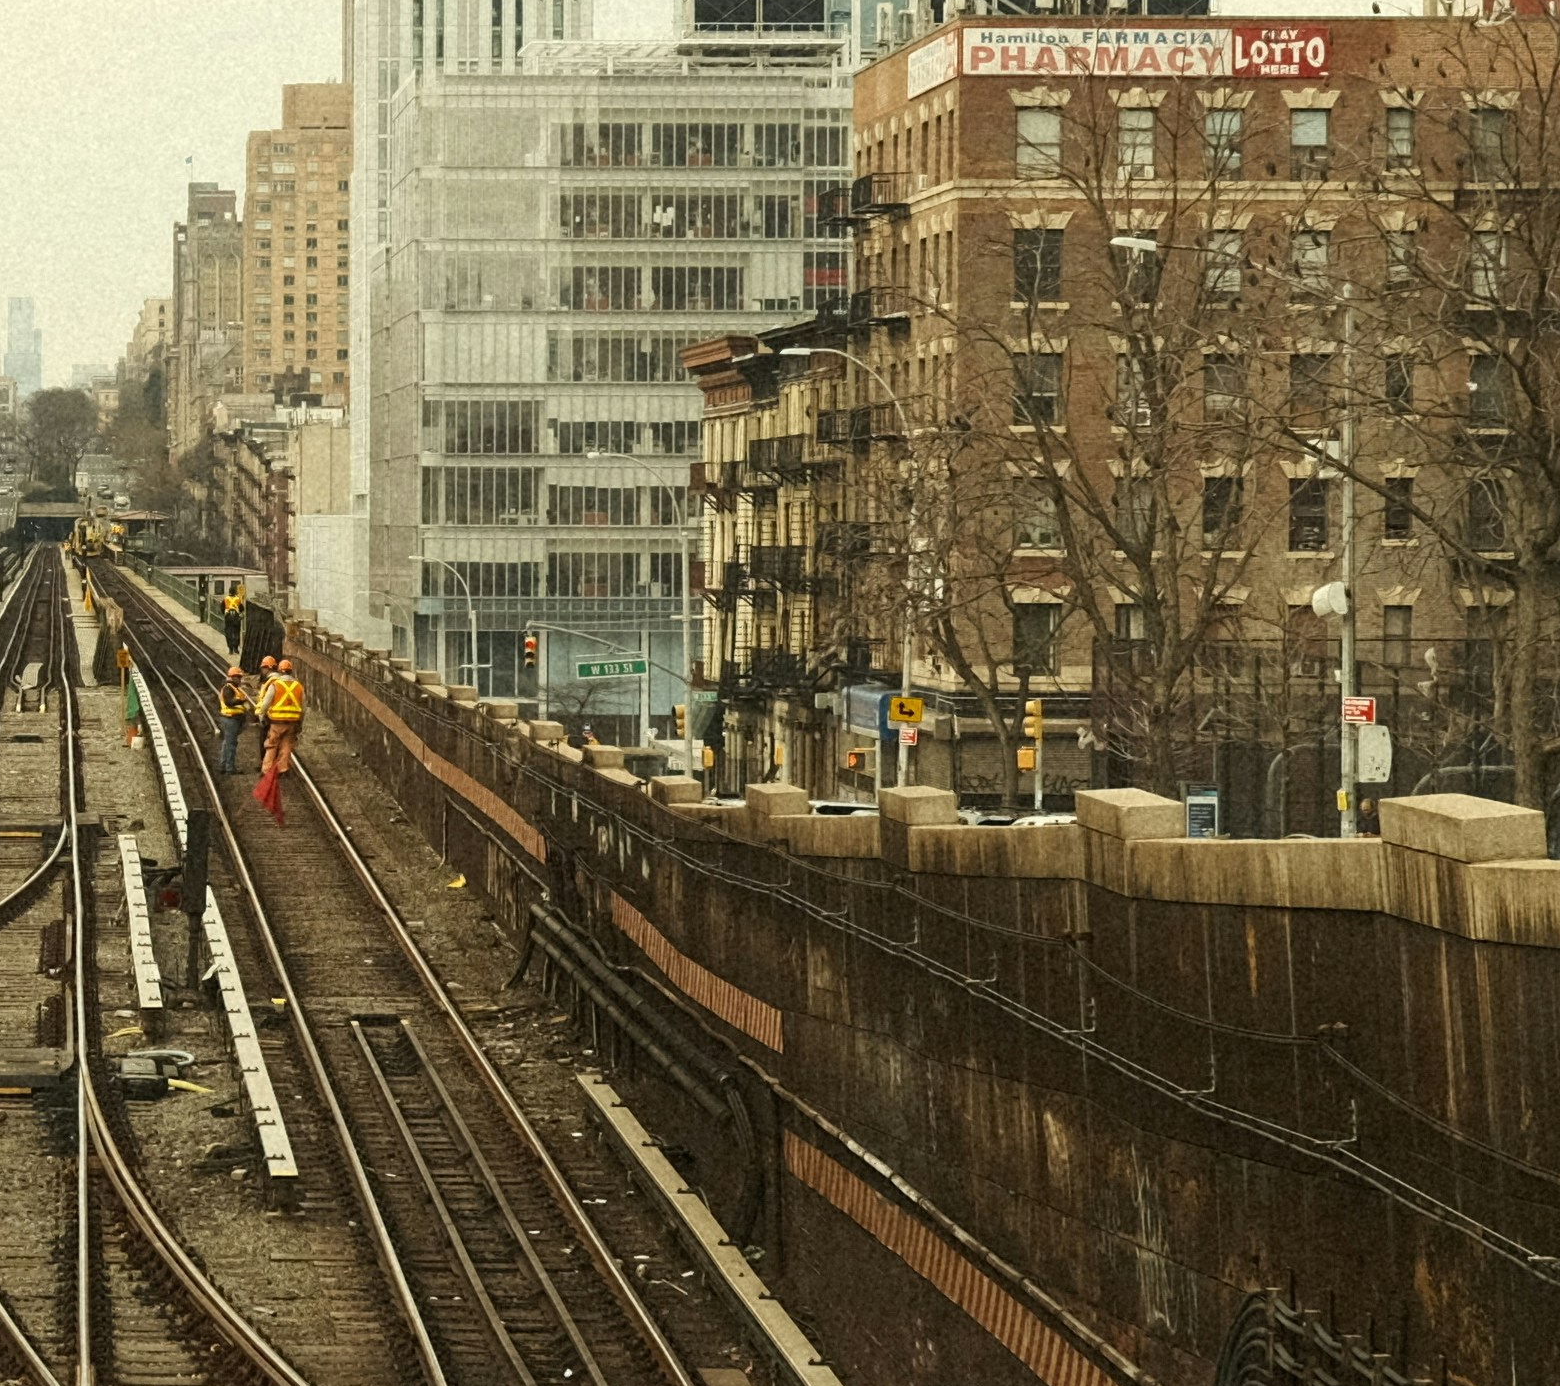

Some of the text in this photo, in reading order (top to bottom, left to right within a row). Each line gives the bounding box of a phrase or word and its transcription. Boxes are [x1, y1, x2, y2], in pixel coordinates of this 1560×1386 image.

[980, 31, 1213, 44] Hamilton FARMACIA
[970, 45, 1222, 72] PHARMACY
[1235, 35, 1325, 69] LOTTO
[1261, 65, 1299, 74] HERE
[591, 665, 600, 675] W
[604, 664, 619, 674] 133
